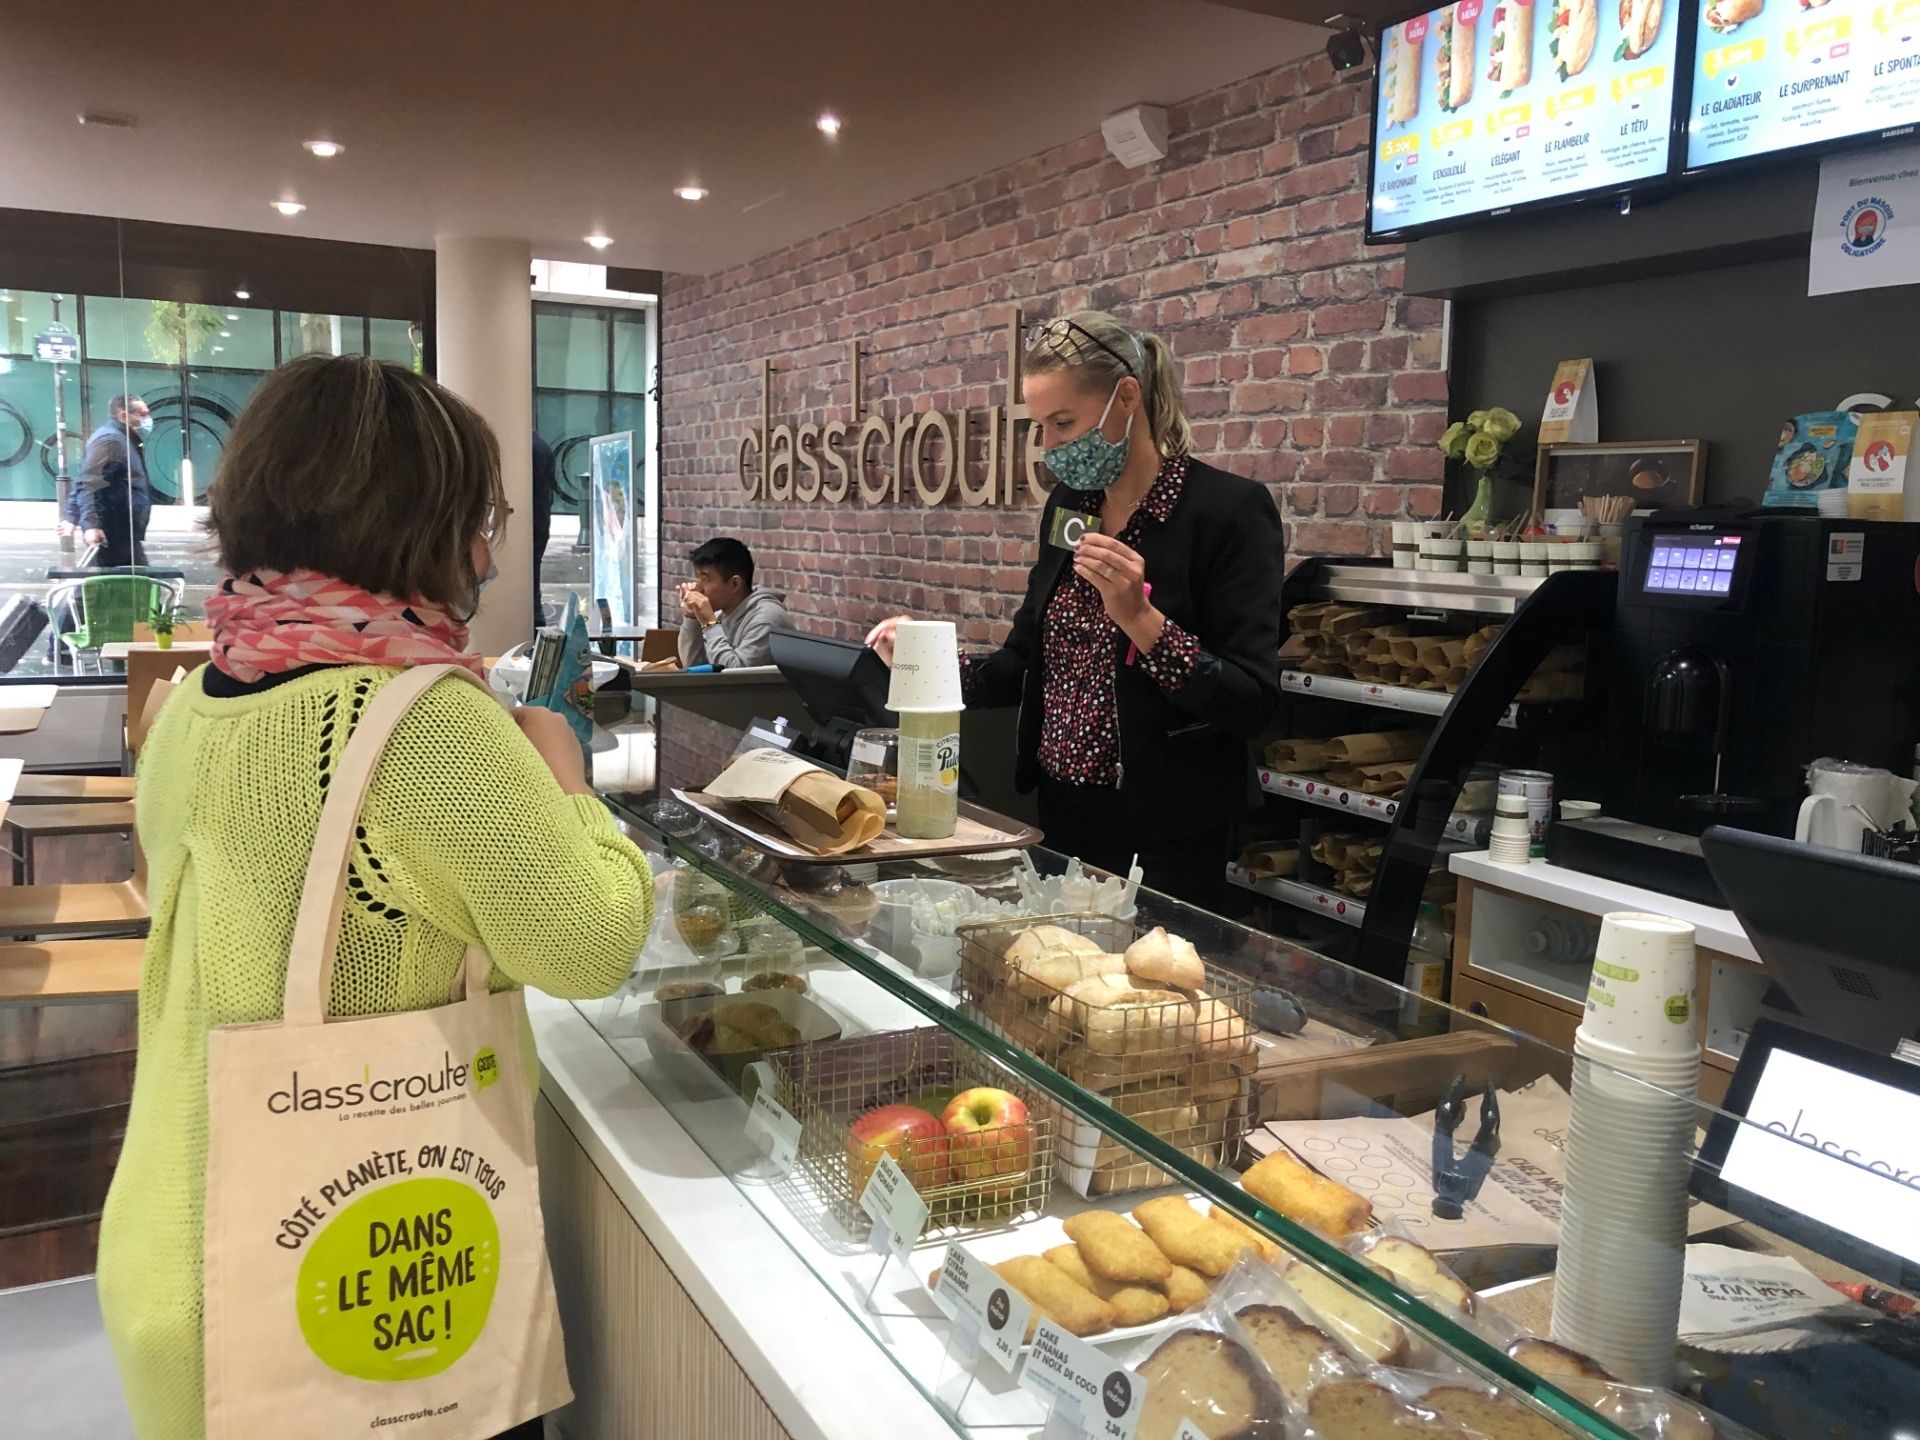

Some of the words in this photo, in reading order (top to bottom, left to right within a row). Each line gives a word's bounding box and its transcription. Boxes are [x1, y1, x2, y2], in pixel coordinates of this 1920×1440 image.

[1874, 62, 1884, 76] LE
[1779, 82, 1789, 98] LE
[1791, 70, 1850, 95] SURPRENANT
[1701, 103, 1710, 116] LE
[1620, 124, 1628, 136] LE
[1631, 119, 1648, 133] TÊTU
[1882, 126, 1914, 138] SAMSUNG
[1545, 142, 1552, 153] LE
[1554, 132, 1591, 151] FLAMBEUR
[1379, 180, 1386, 192] LE
[1848, 172, 1897, 188] Bienvenue
[1898, 169, 1919, 180] chez
[1840, 204, 1857, 228] PORT
[1857, 197, 1870, 208] DU
[1870, 196, 1895, 221] MASQUE
[1840, 237, 1888, 259] OBLIGATOIRE
[338, 1113, 350, 1122] La
[353, 1108, 386, 1119] recette
[390, 1105, 407, 1115] des
[410, 1100, 435, 1112] belles
[1508, 1158, 1547, 1176] CHEZ
[275, 1195, 325, 1250] CÔTÉ
[319, 1149, 414, 1207] PLANÈTE,
[418, 1144, 447, 1169] ON
[450, 1146, 475, 1173] EST
[476, 1156, 506, 1201] TOUS
[369, 1208, 453, 1258] DANS
[949, 1248, 965, 1266] CAKE
[338, 1270, 373, 1312] LE
[389, 1245, 477, 1303] MÊME
[947, 1257, 968, 1280] CITRON
[944, 1267, 970, 1293] AMANDE
[1039, 1327, 1059, 1345] CAKE
[1036, 1338, 1069, 1364] ANANAS
[1032, 1348, 1041, 1358] ET
[1042, 1354, 1063, 1374] NOIX
[1063, 1367, 1074, 1380] DE
[1075, 1375, 1098, 1396] COCO
[370, 1401, 459, 1429] classcroute.com
